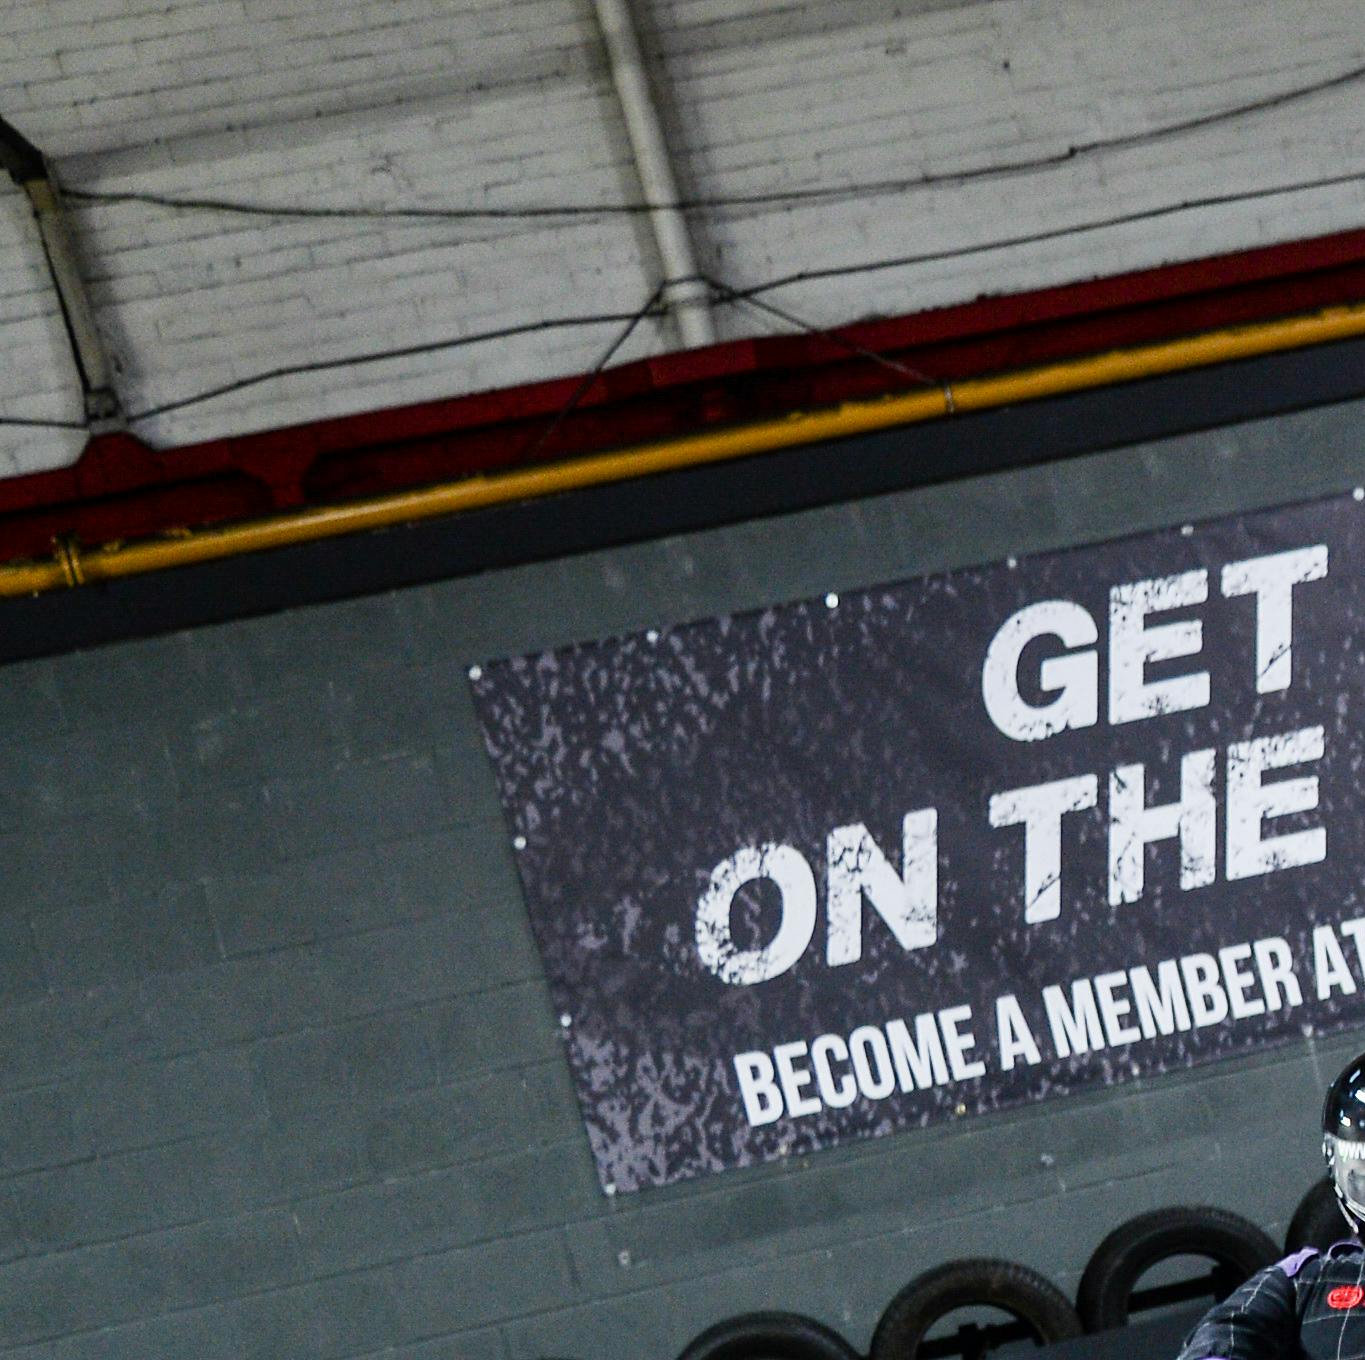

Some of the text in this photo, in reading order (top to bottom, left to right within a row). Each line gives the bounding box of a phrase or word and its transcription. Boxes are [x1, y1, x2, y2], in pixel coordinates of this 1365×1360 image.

[982, 544, 1329, 742] GET
[695, 724, 1327, 986] ON THE
[733, 1004, 986, 1127] BECOME
[996, 994, 1042, 1071] A
[1042, 937, 1303, 1059] MEMBER
